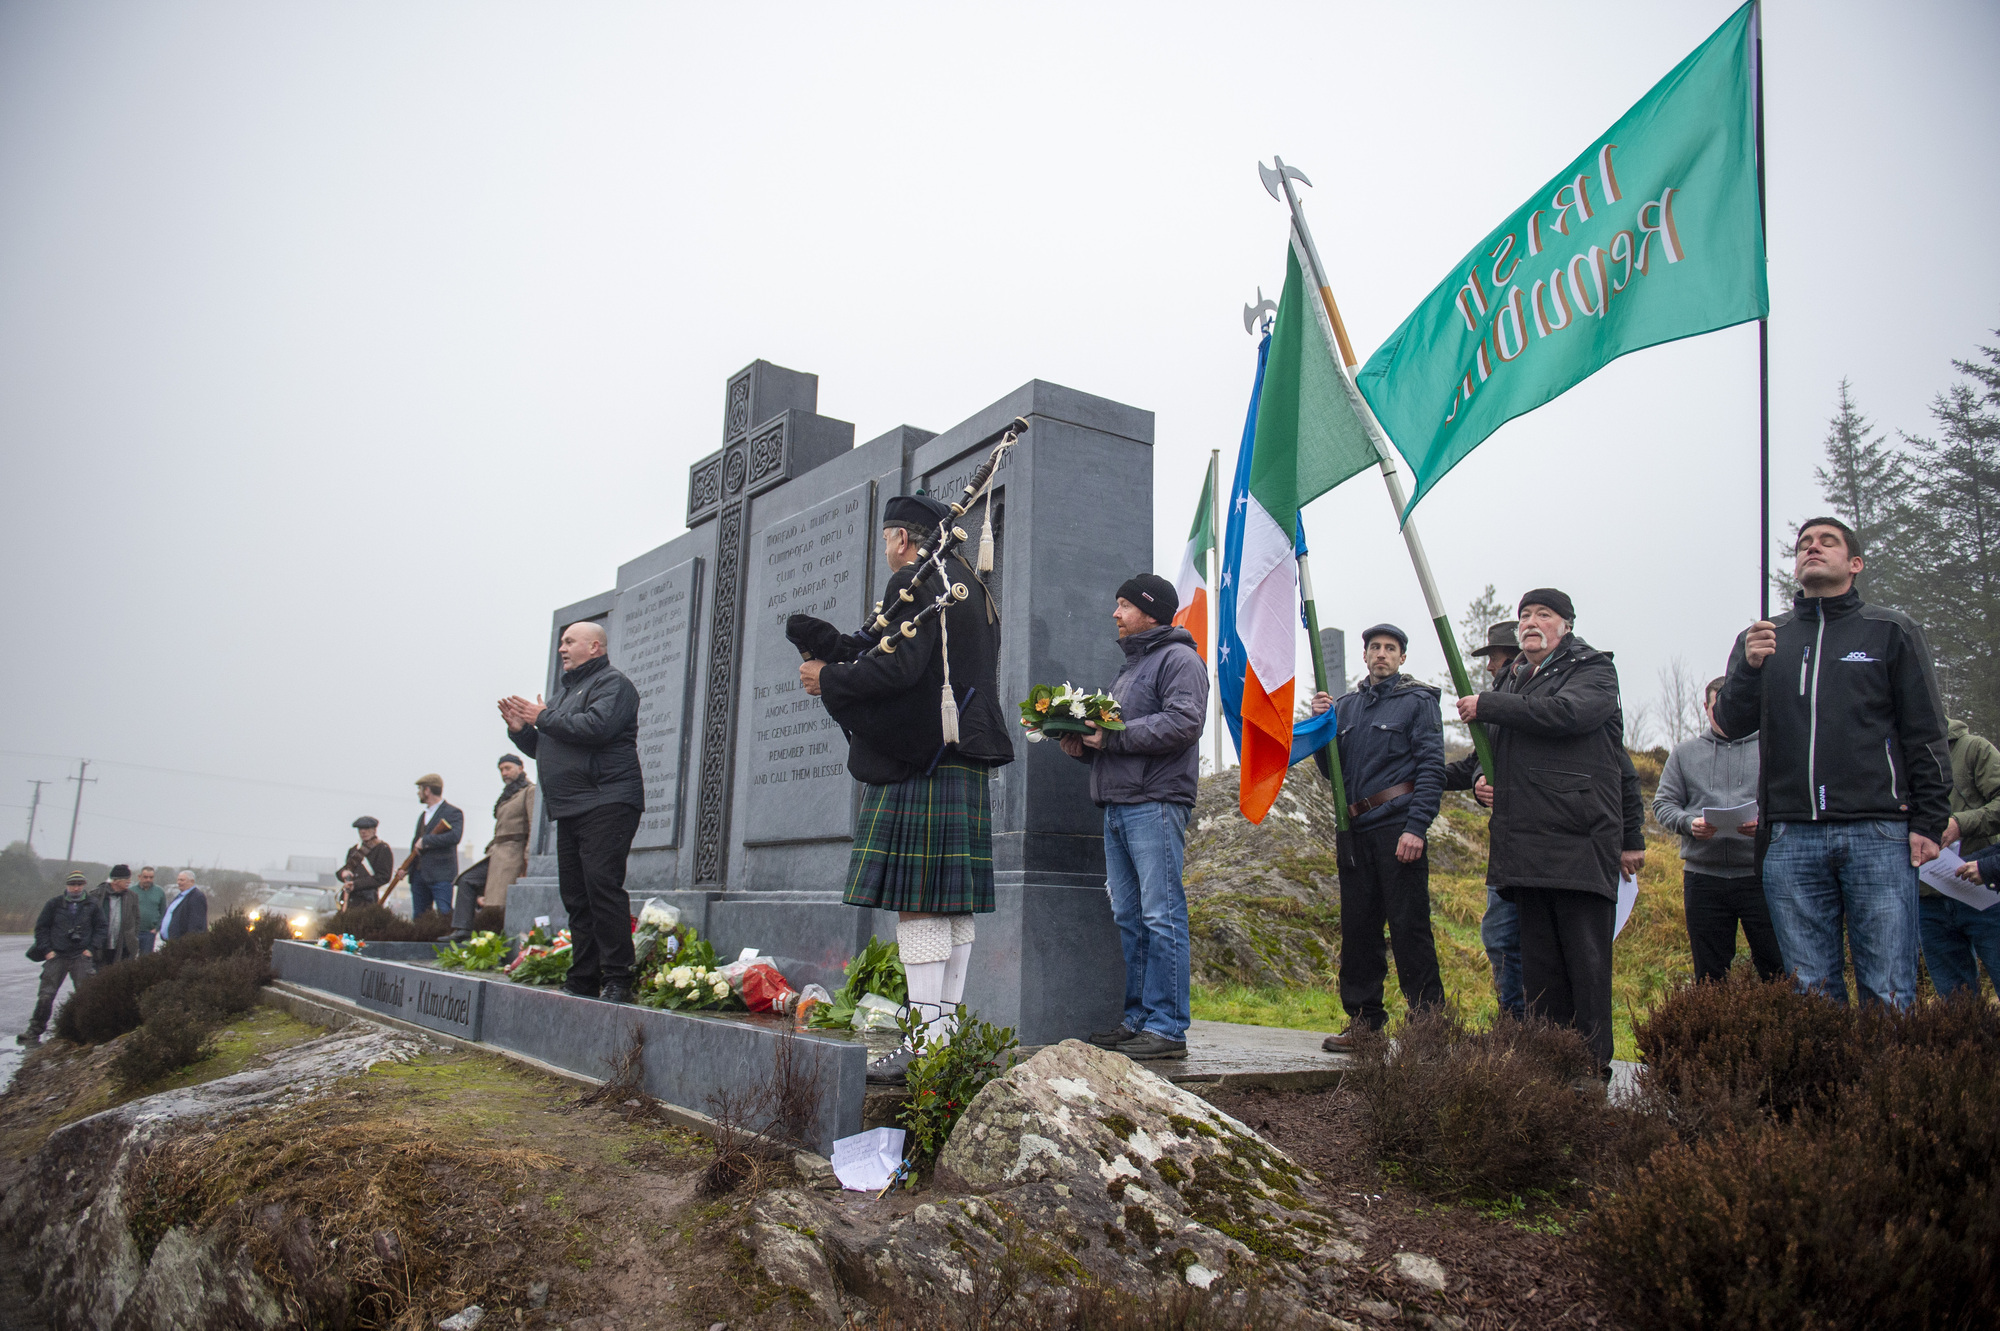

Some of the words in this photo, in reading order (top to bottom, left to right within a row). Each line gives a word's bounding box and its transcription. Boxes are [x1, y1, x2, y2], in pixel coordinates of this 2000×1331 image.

[845, 499, 859, 515] IAD
[802, 561, 813, 578] GO
[768, 592, 787, 609] AGUS
[833, 570, 849, 590] GUR
[823, 596, 837, 611] IAD
[754, 686, 771, 700] THEY
[775, 680, 796, 695] SHALL
[765, 704, 789, 719] AMONG
[791, 700, 810, 713] THEIR
[757, 729, 770, 742] THE
[771, 720, 818, 739] GENERATIONS
[768, 745, 804, 762] REMEMBER
[754, 774, 768, 786] AND
[770, 771, 788, 784] CALL
[791, 767, 810, 781] THEM
[813, 763, 844, 779] BLESSED
[417, 980, 472, 1025] Kilmichael
